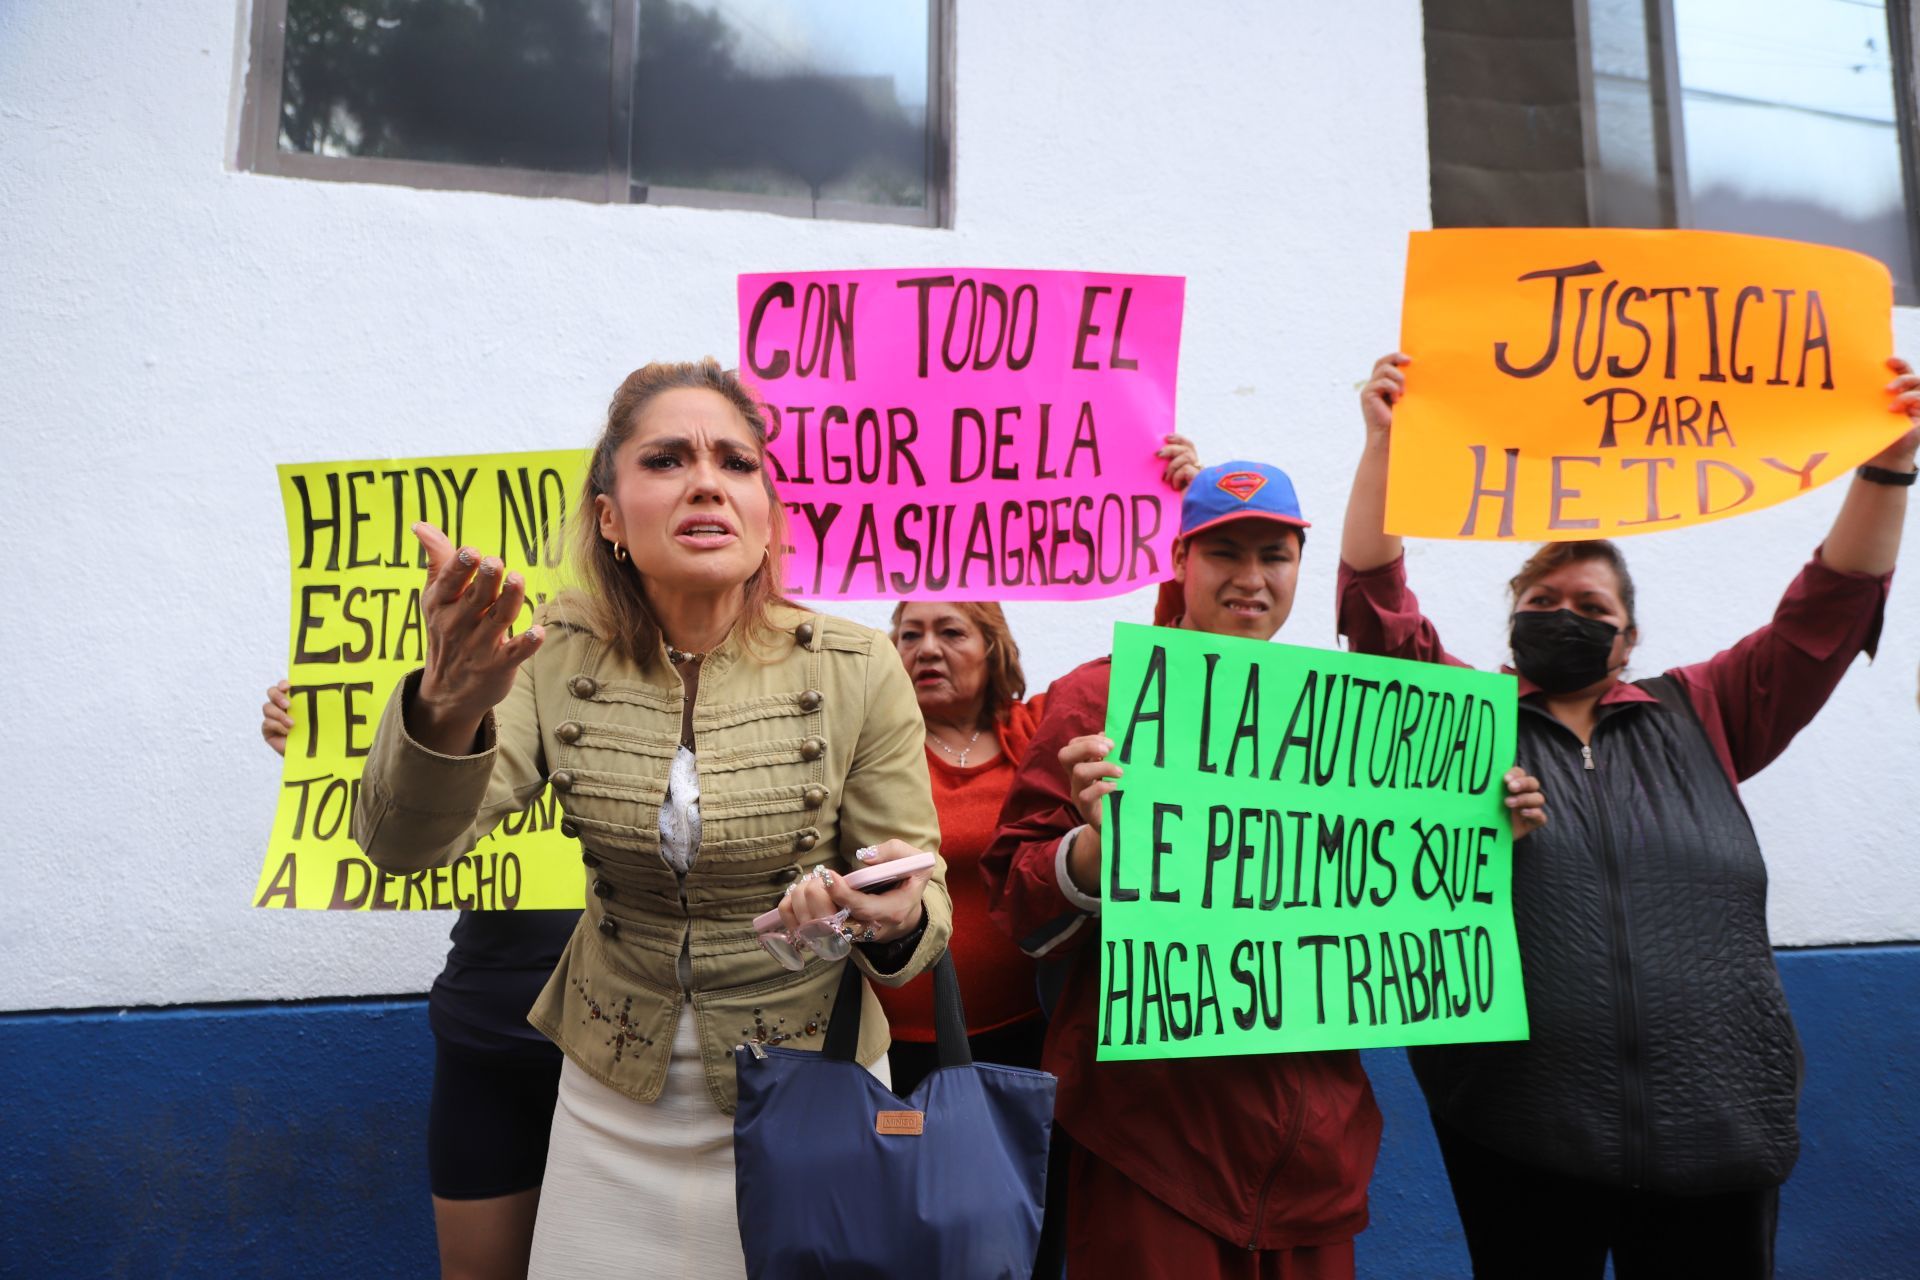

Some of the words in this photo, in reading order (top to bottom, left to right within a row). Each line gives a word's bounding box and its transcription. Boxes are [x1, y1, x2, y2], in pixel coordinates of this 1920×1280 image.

[746, 281, 859, 381] CON
[897, 275, 1039, 378] TODO
[1072, 286, 1138, 371] EL
[1493, 260, 1835, 390] JUSTICIA
[949, 405, 1022, 483] DE
[1035, 401, 1102, 479] LA
[1583, 387, 1736, 448] PARA
[291, 466, 478, 572] HEIDY
[497, 467, 566, 570] NO
[839, 502, 886, 594] A
[891, 502, 956, 593] SU
[957, 493, 1162, 588] AGRESOR
[1457, 444, 1830, 538] HEIDY
[1119, 645, 1167, 768] A
[1198, 653, 1260, 779] LA
[1269, 669, 1496, 796] AUTORIDAD
[258, 852, 298, 909] A
[326, 850, 522, 911] DERECHO
[1108, 789, 1183, 903] LE
[1201, 804, 1398, 911] PEDIMOS
[1410, 817, 1498, 912] QUE
[1100, 938, 1225, 1047] HAGA
[1230, 938, 1283, 1031] SU
[1298, 925, 1495, 1026] TRABAJO
